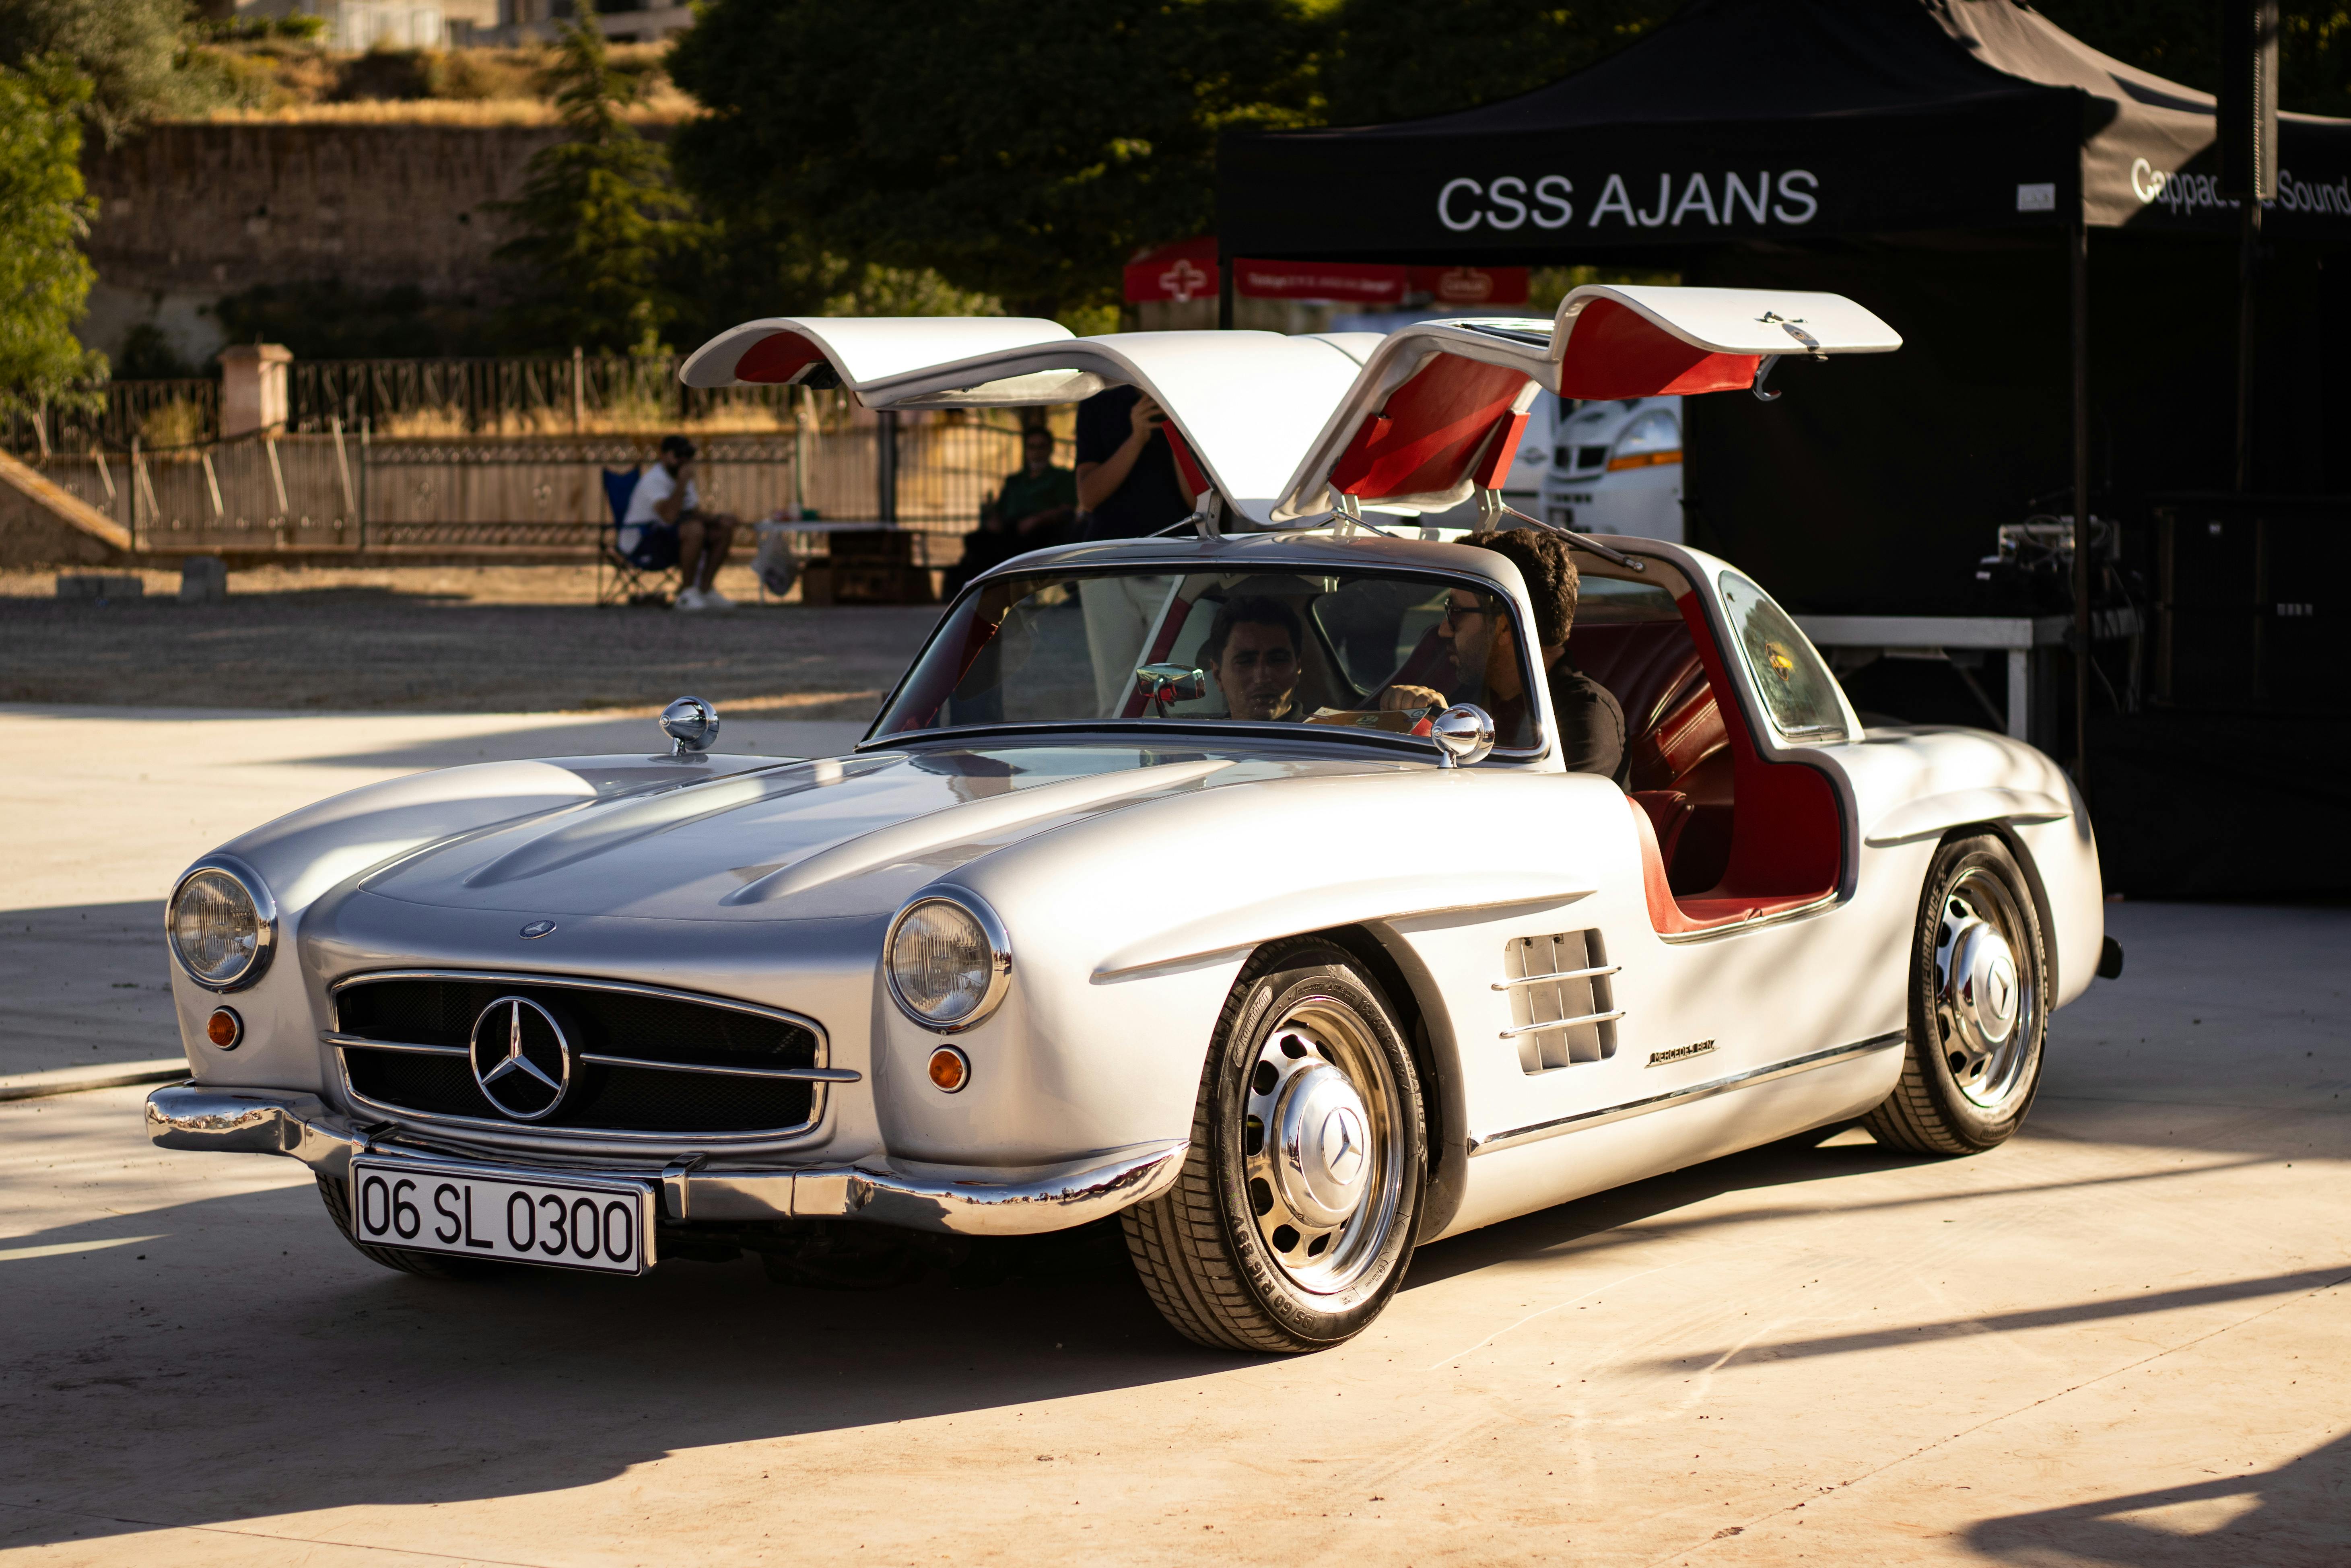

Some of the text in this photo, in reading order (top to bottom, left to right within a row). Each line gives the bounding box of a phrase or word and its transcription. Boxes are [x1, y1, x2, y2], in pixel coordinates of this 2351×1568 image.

[1437, 169, 1819, 231] CSS AJANS
[1922, 888, 1941, 1020] PERFORMANCE
[1361, 1000, 1385, 1030] 195/60
[1654, 1045, 1694, 1063] MERCEDES
[363, 1175, 633, 1263] 06 SL 0300
[1232, 1216, 1317, 1330] 195/60 R 16 89 V
